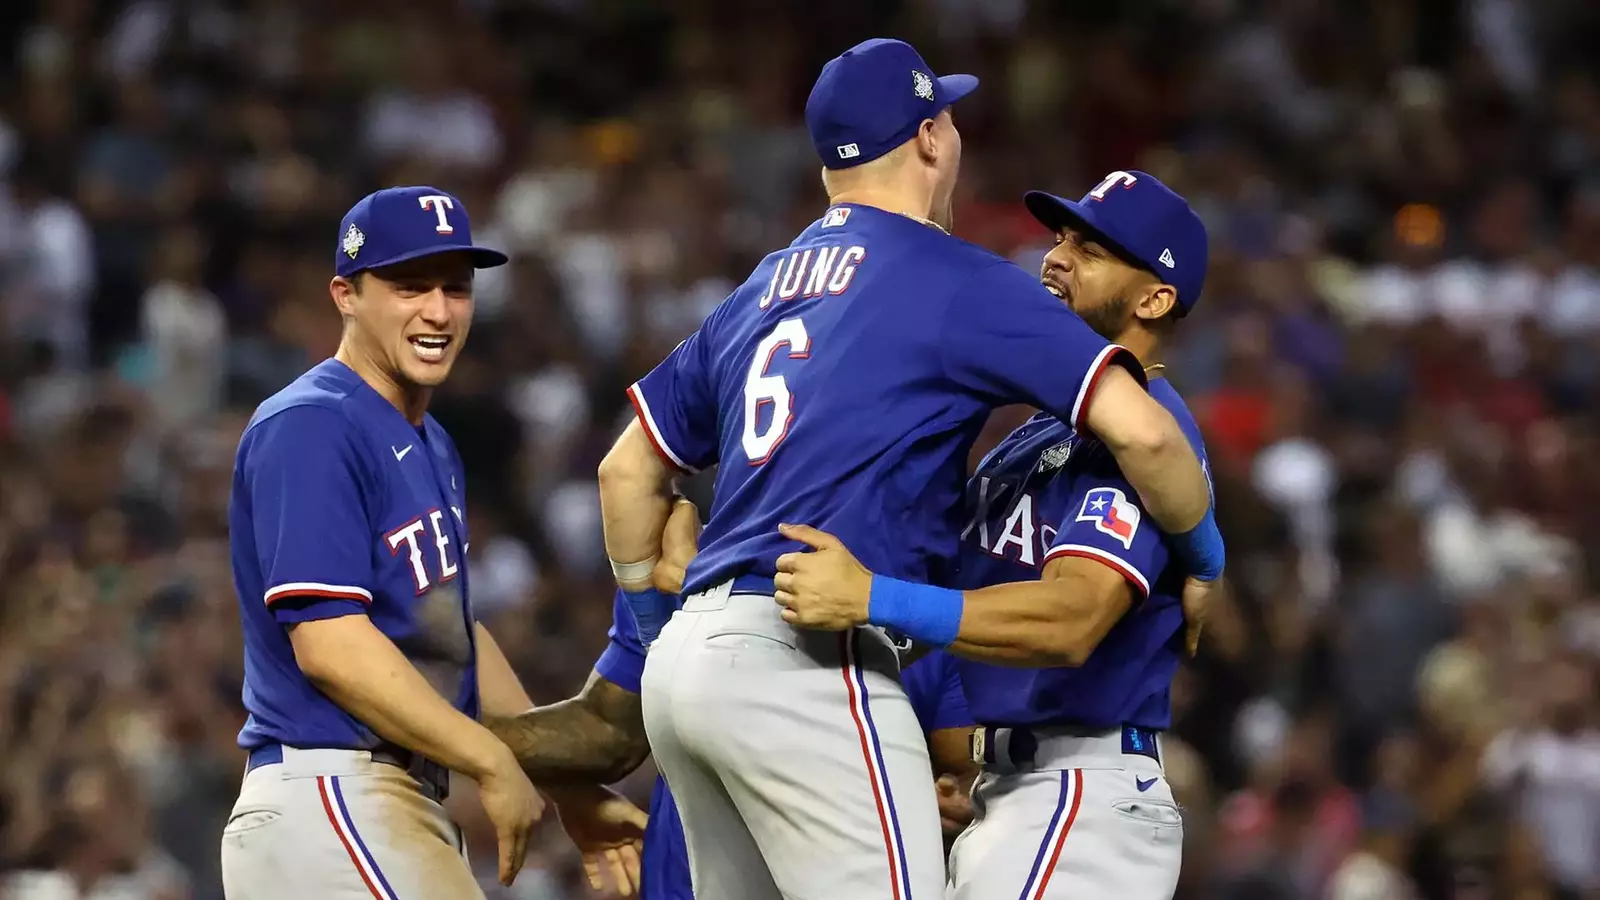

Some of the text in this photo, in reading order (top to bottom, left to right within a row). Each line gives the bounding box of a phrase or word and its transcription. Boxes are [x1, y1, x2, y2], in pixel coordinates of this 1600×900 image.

[1090, 170, 1137, 202] T
[418, 195, 454, 236] T
[759, 246, 866, 311] JUNG
[742, 317, 812, 466] 6
